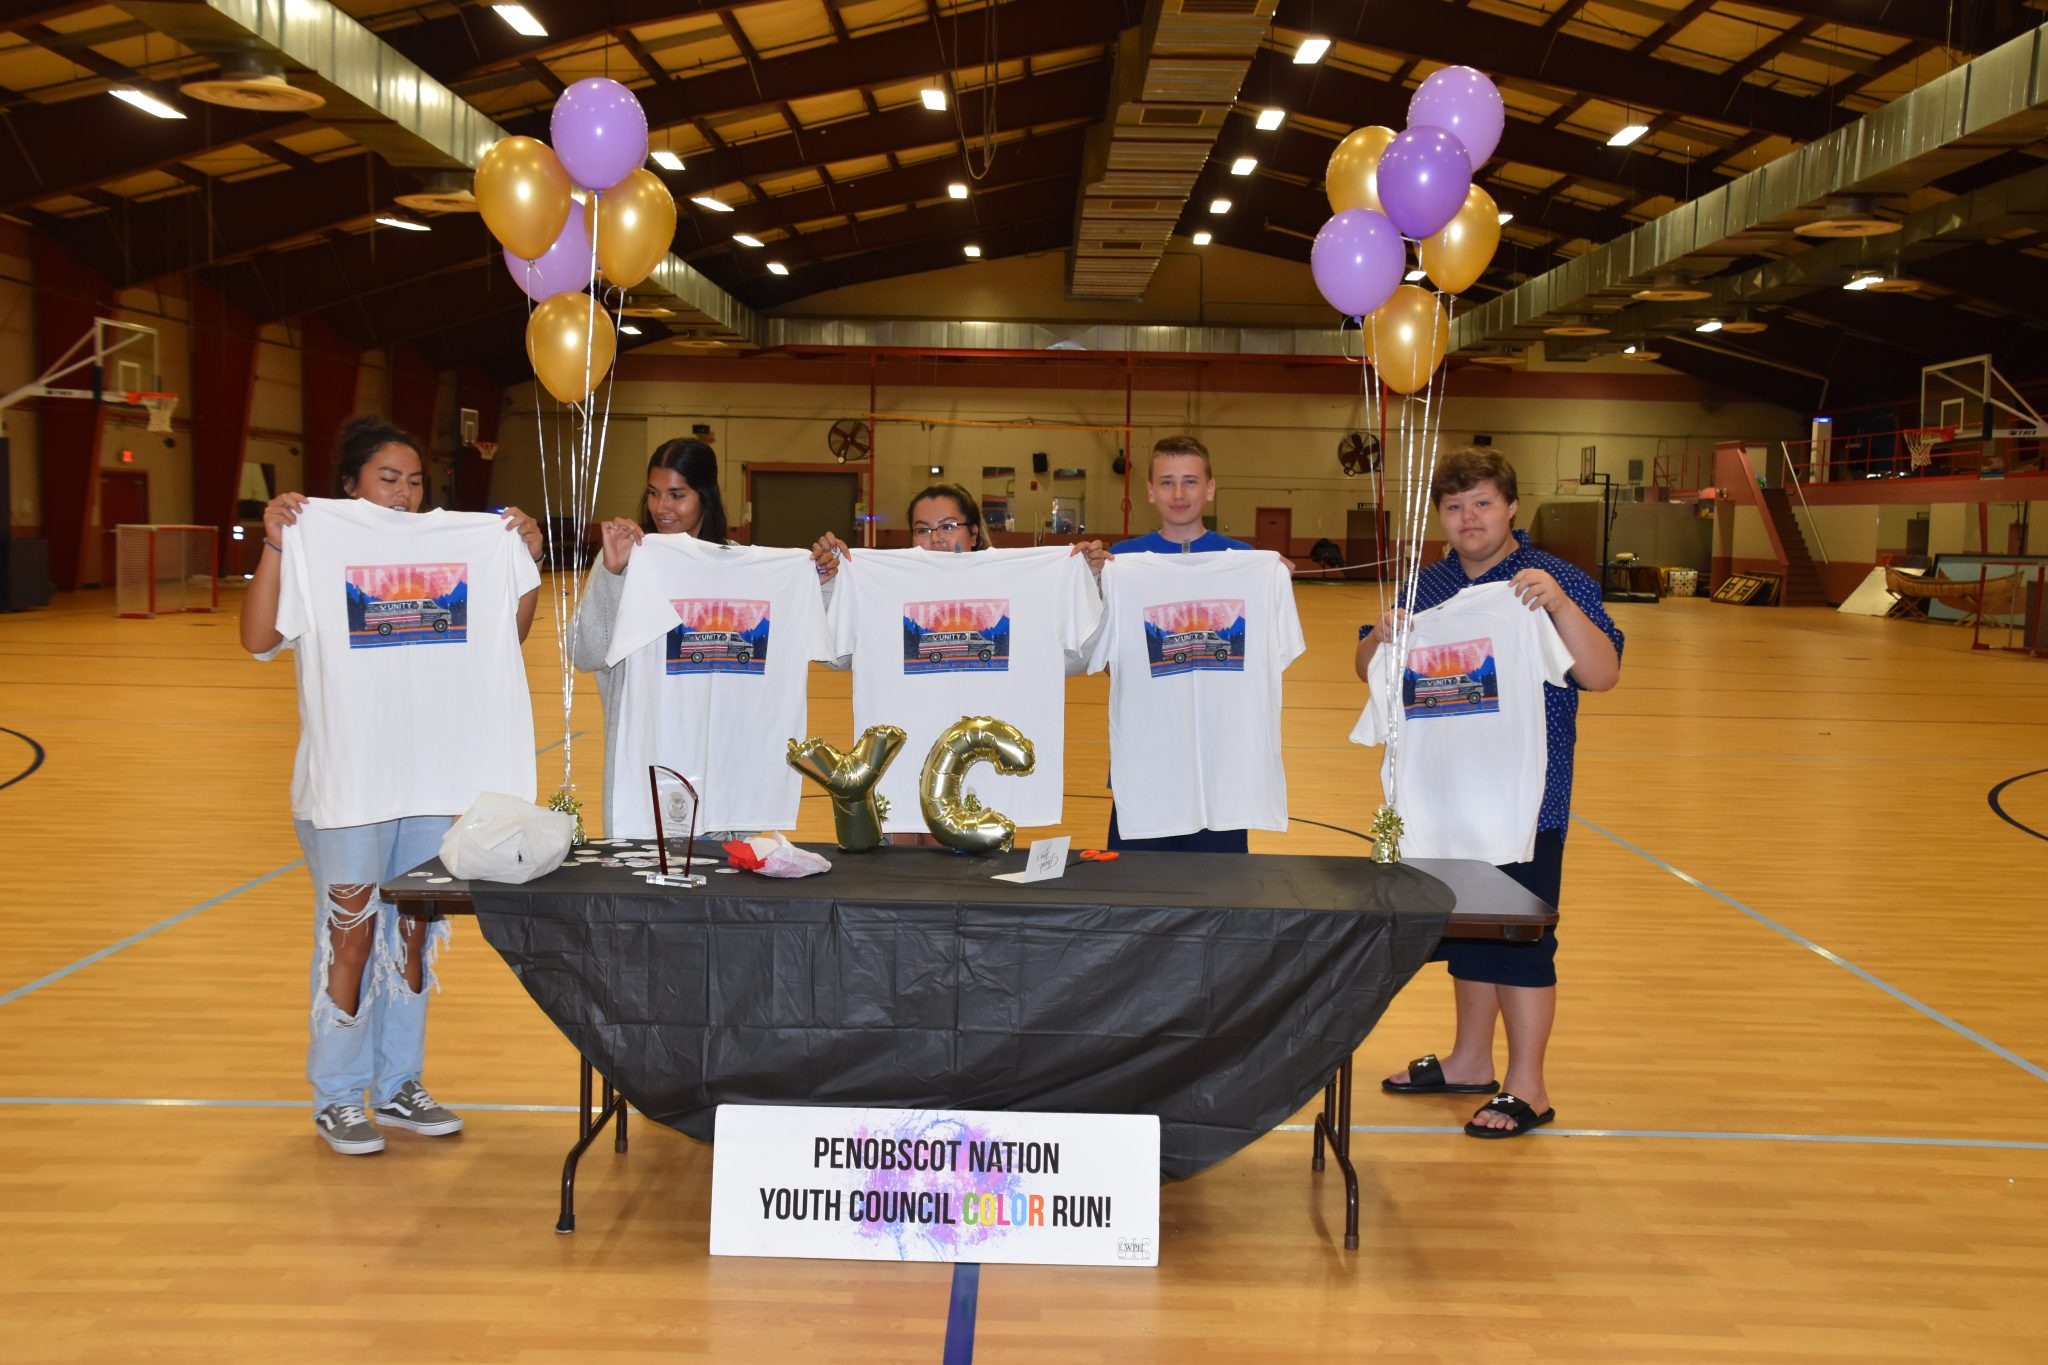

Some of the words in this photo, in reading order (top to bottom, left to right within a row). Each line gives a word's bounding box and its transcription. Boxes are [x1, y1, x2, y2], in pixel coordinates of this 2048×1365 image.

[346, 566, 466, 595] UNITY
[388, 602, 412, 610] UNITY
[904, 601, 1008, 627] UNITY
[1144, 602, 1244, 629] UNITY
[940, 633, 961, 641] UNITY
[814, 1137, 961, 1171] PENOBSCOT
[969, 1141, 1060, 1174] NATION
[760, 1188, 841, 1221] YOUTH
[849, 1190, 956, 1224] COUNCIL
[963, 1192, 1045, 1226] COLOR
[1053, 1195, 1111, 1228] RUN!
